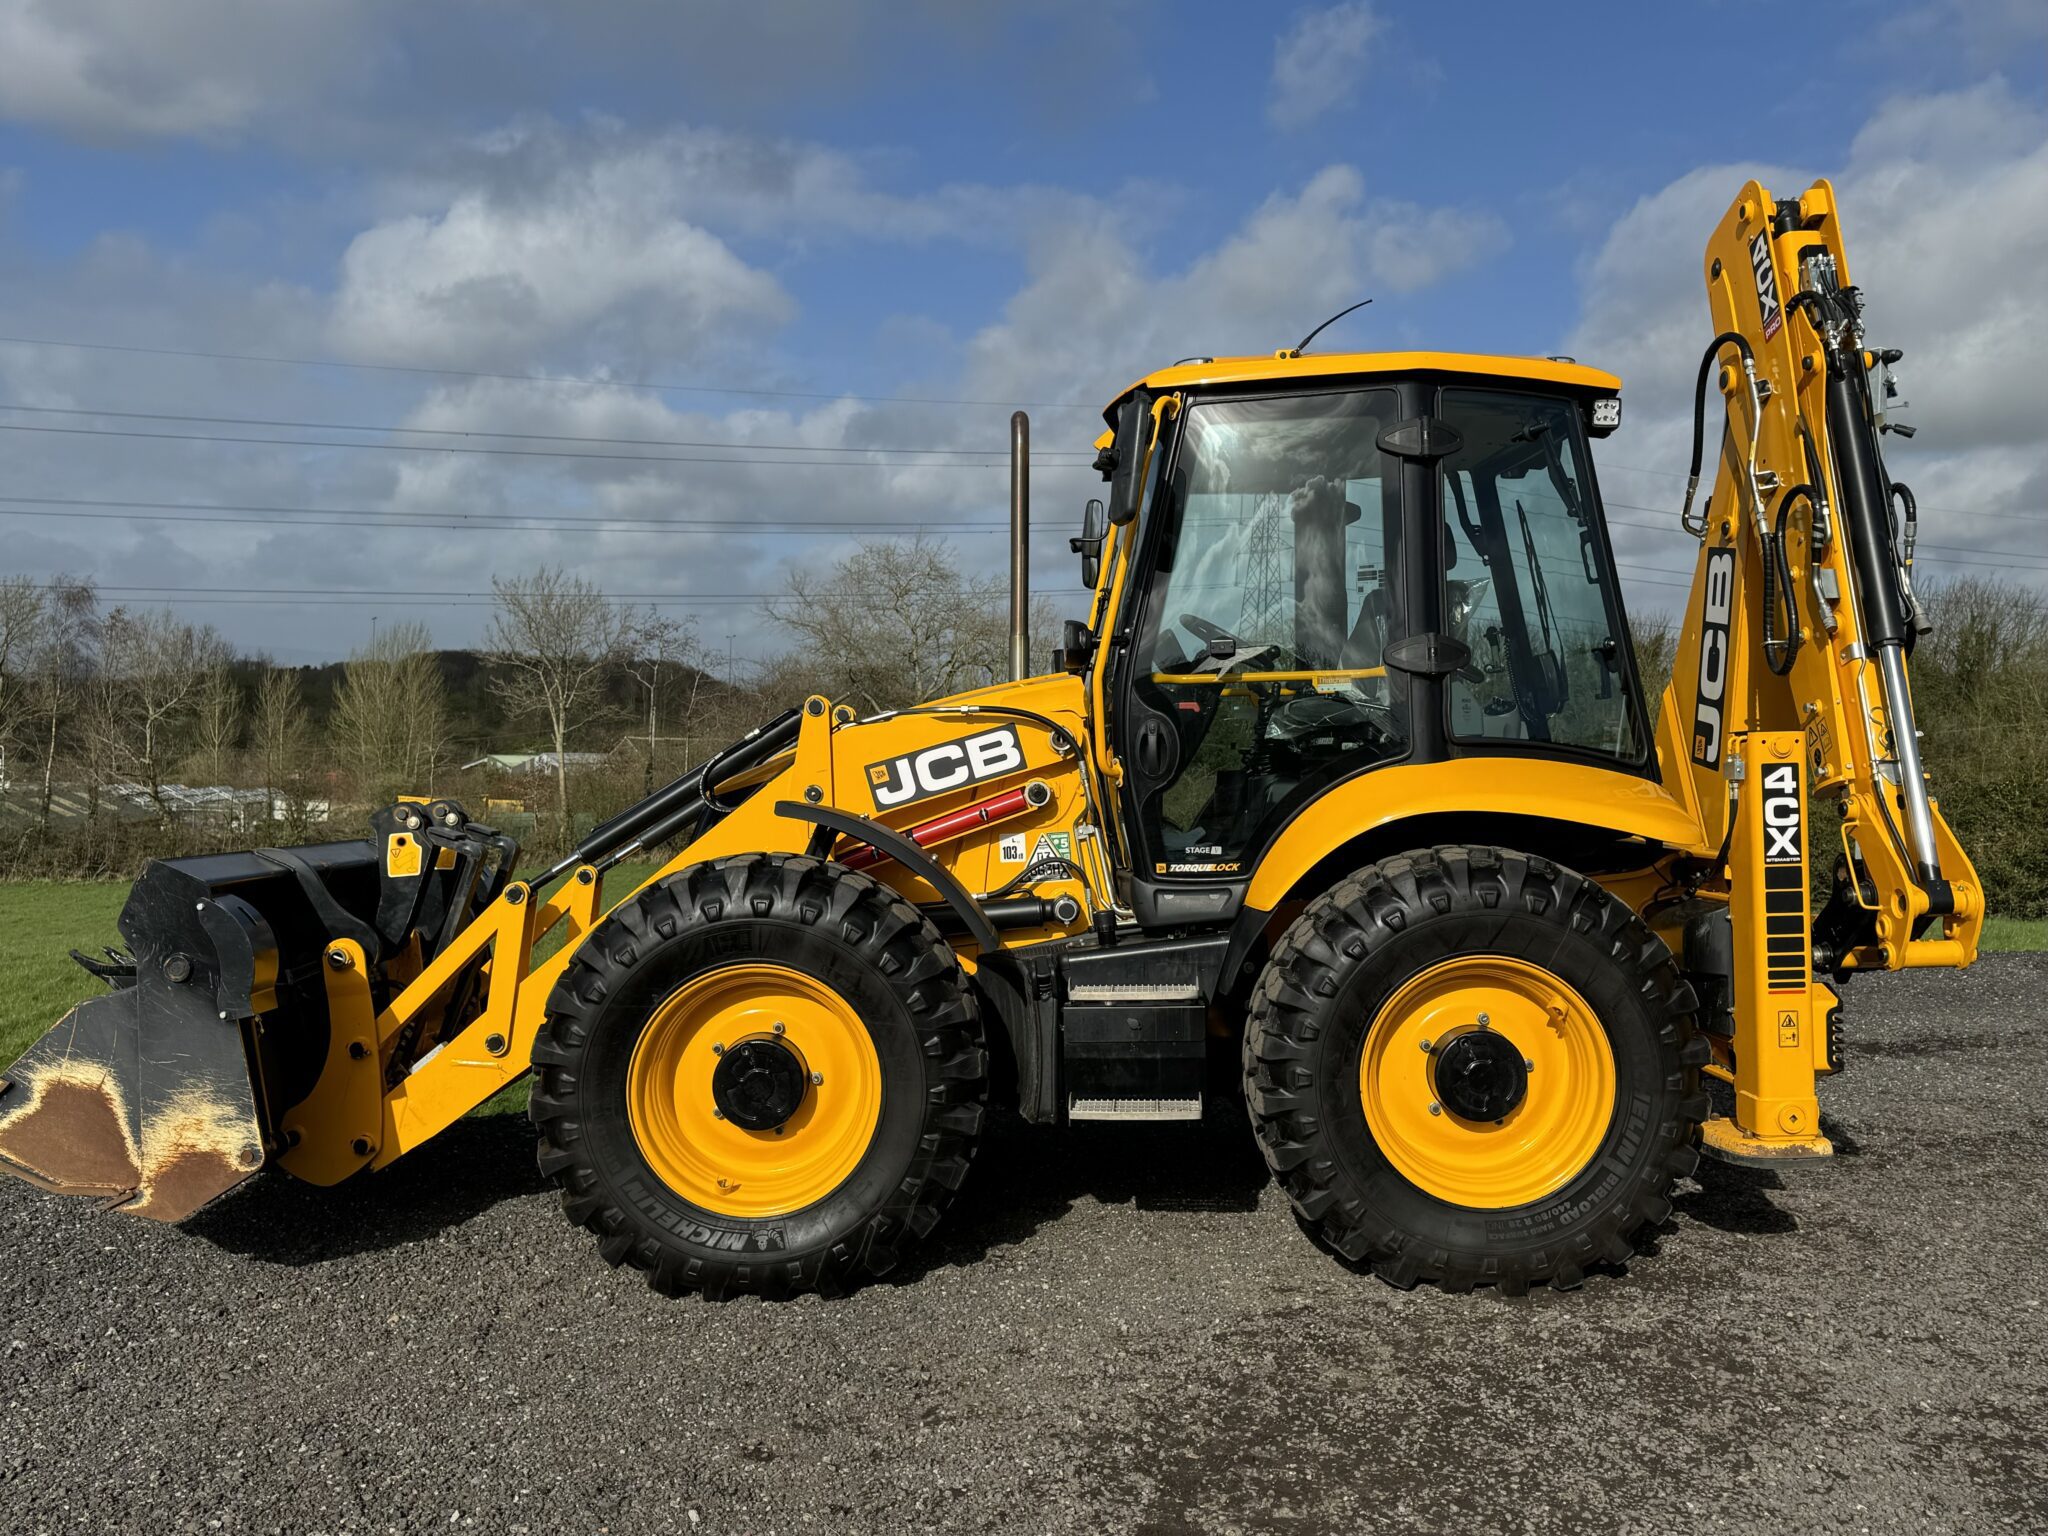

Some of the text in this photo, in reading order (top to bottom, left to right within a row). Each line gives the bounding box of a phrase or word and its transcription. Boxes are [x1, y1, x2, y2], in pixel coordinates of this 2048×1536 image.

[1753, 233, 1778, 322] 4CX
[1765, 316, 1781, 339] PRO
[1698, 553, 1733, 763] JCB
[876, 730, 1021, 805] JCB
[1764, 766, 1800, 856] 4CX
[1002, 845, 1018, 860] 103
[1060, 838, 1068, 848] 5
[1185, 846, 1210, 854] STAGE
[1169, 863, 1241, 872] TORQUELOCK
[621, 1180, 749, 1251] MICHELIN
[1560, 1172, 1620, 1225] BIBLOAD
[1524, 1216, 1533, 1226] R
